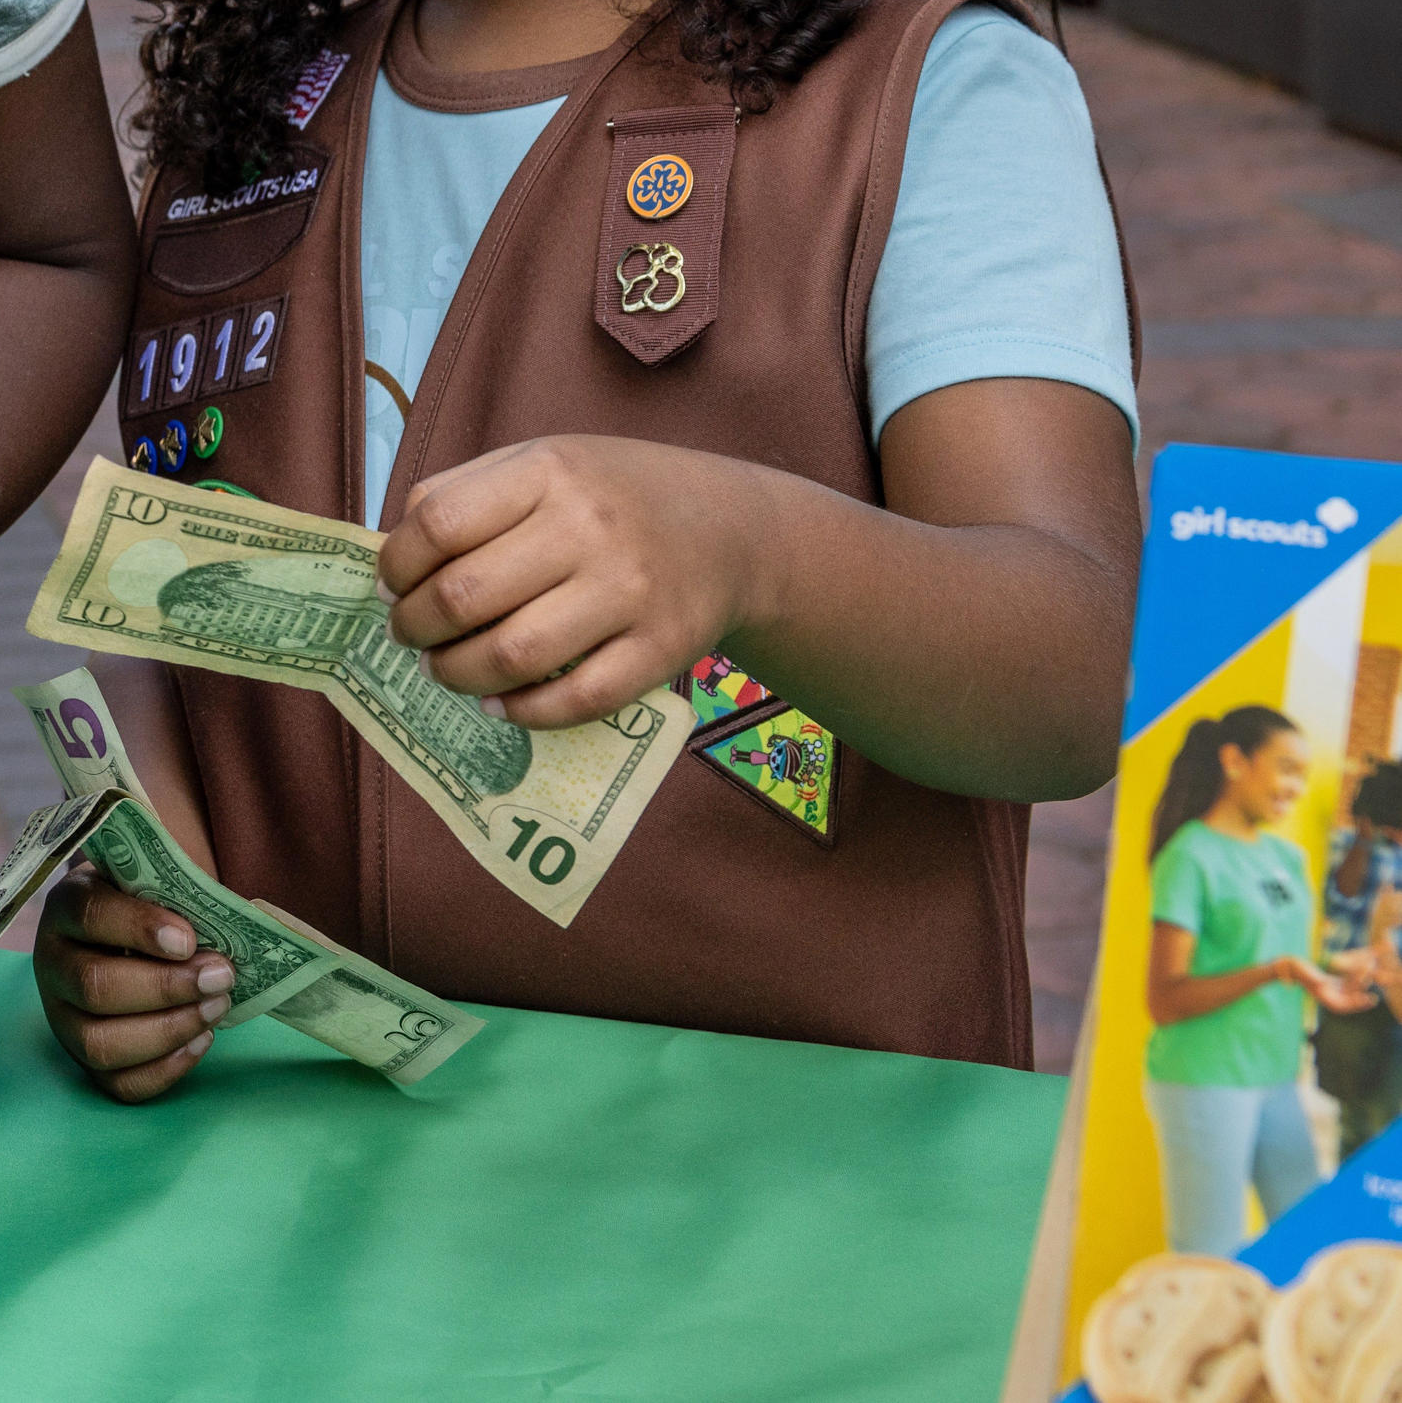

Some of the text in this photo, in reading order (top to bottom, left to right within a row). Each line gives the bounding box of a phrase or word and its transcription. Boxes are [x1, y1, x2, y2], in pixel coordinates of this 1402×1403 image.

[167, 167, 319, 220] GIRL SCOUTS USA
[139, 311, 276, 402] 1912
[109, 488, 168, 525] 10
[1170, 505, 1328, 549] girl scouts
[181, 519, 348, 555] THE UNITED
[313, 561, 334, 571] IN
[61, 598, 127, 628] 10
[46, 698, 108, 759] 5
[505, 815, 577, 885] 10
